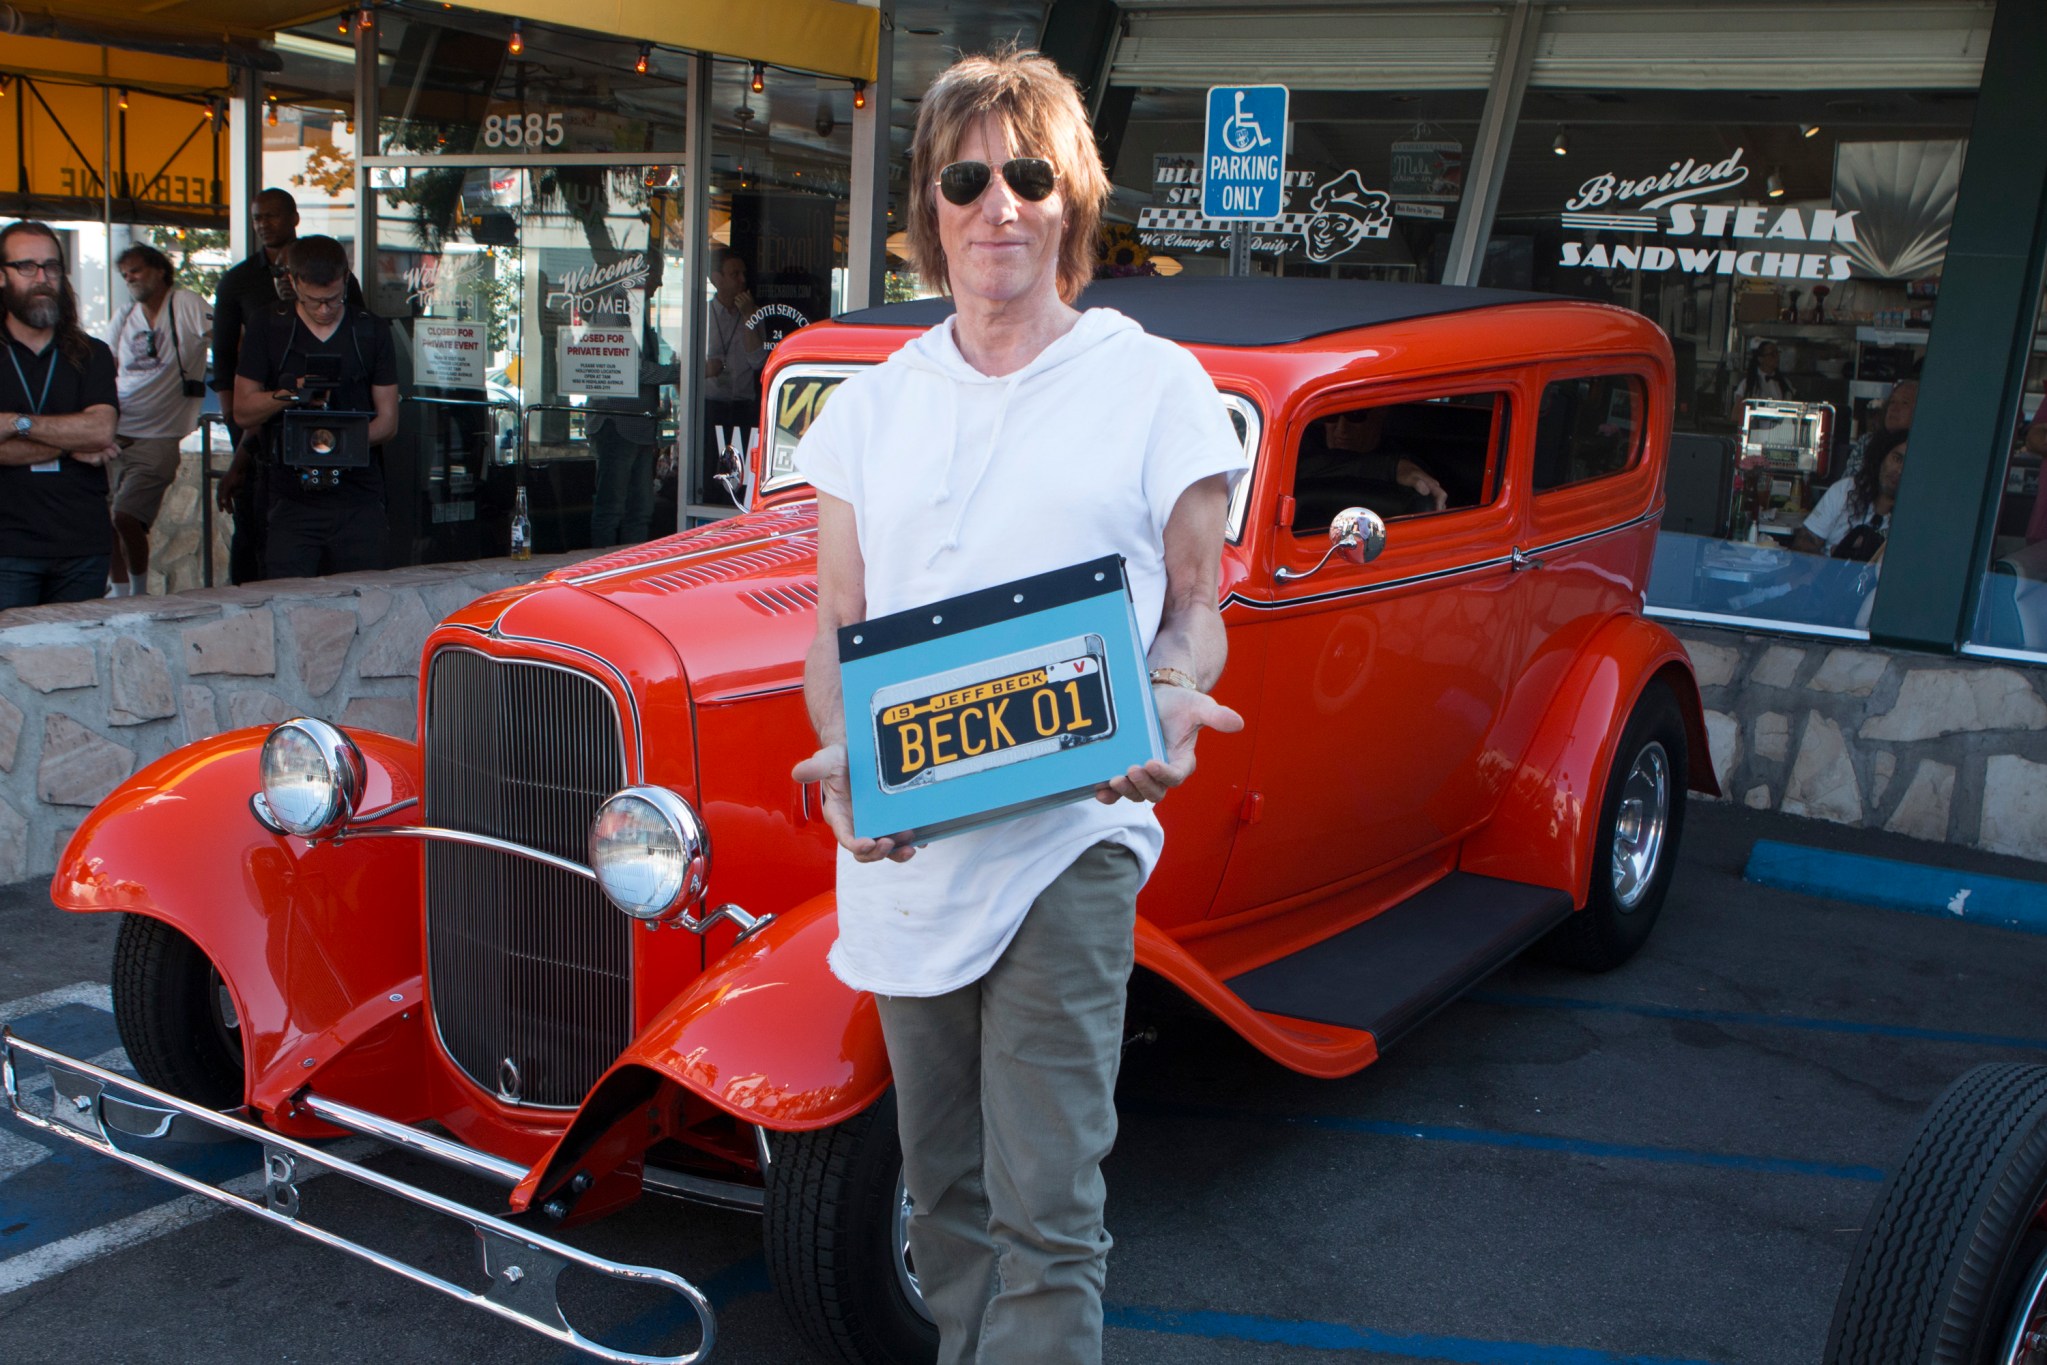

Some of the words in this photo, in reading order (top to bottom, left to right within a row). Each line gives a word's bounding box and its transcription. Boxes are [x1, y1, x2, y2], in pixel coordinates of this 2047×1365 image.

[484, 113, 564, 147] 8585
[1155, 167, 1204, 184] BLU
[1210, 155, 1279, 181] PARKING
[1566, 147, 1749, 212] Broiled
[1222, 185, 1264, 211] ONLY
[1666, 203, 1861, 242] STEAK
[1140, 232, 1160, 246] We
[1164, 233, 1214, 252] Change
[1219, 236, 1232, 249] 'E
[1251, 235, 1299, 256] Daily!
[559, 253, 645, 296] Welcome
[1559, 242, 1852, 281] SANDWICHES
[570, 294, 594, 313] TO
[745, 304, 776, 330] BOOTH
[776, 303, 810, 328] SERVIC
[427, 327, 457, 336] CLOSED
[457, 328, 474, 338] FOR
[454, 341, 479, 350] EVENT
[579, 333, 605, 343] OSED
[607, 334, 624, 343] FOR
[772, 329, 783, 339] 24
[567, 346, 600, 356] PRIVATE
[602, 347, 630, 357] EVENT
[891, 706, 910, 722] 19
[934, 688, 984, 709] JEFF
[992, 672, 1043, 695] BECK
[898, 698, 1016, 774] BECK
[1032, 680, 1093, 737] 01
